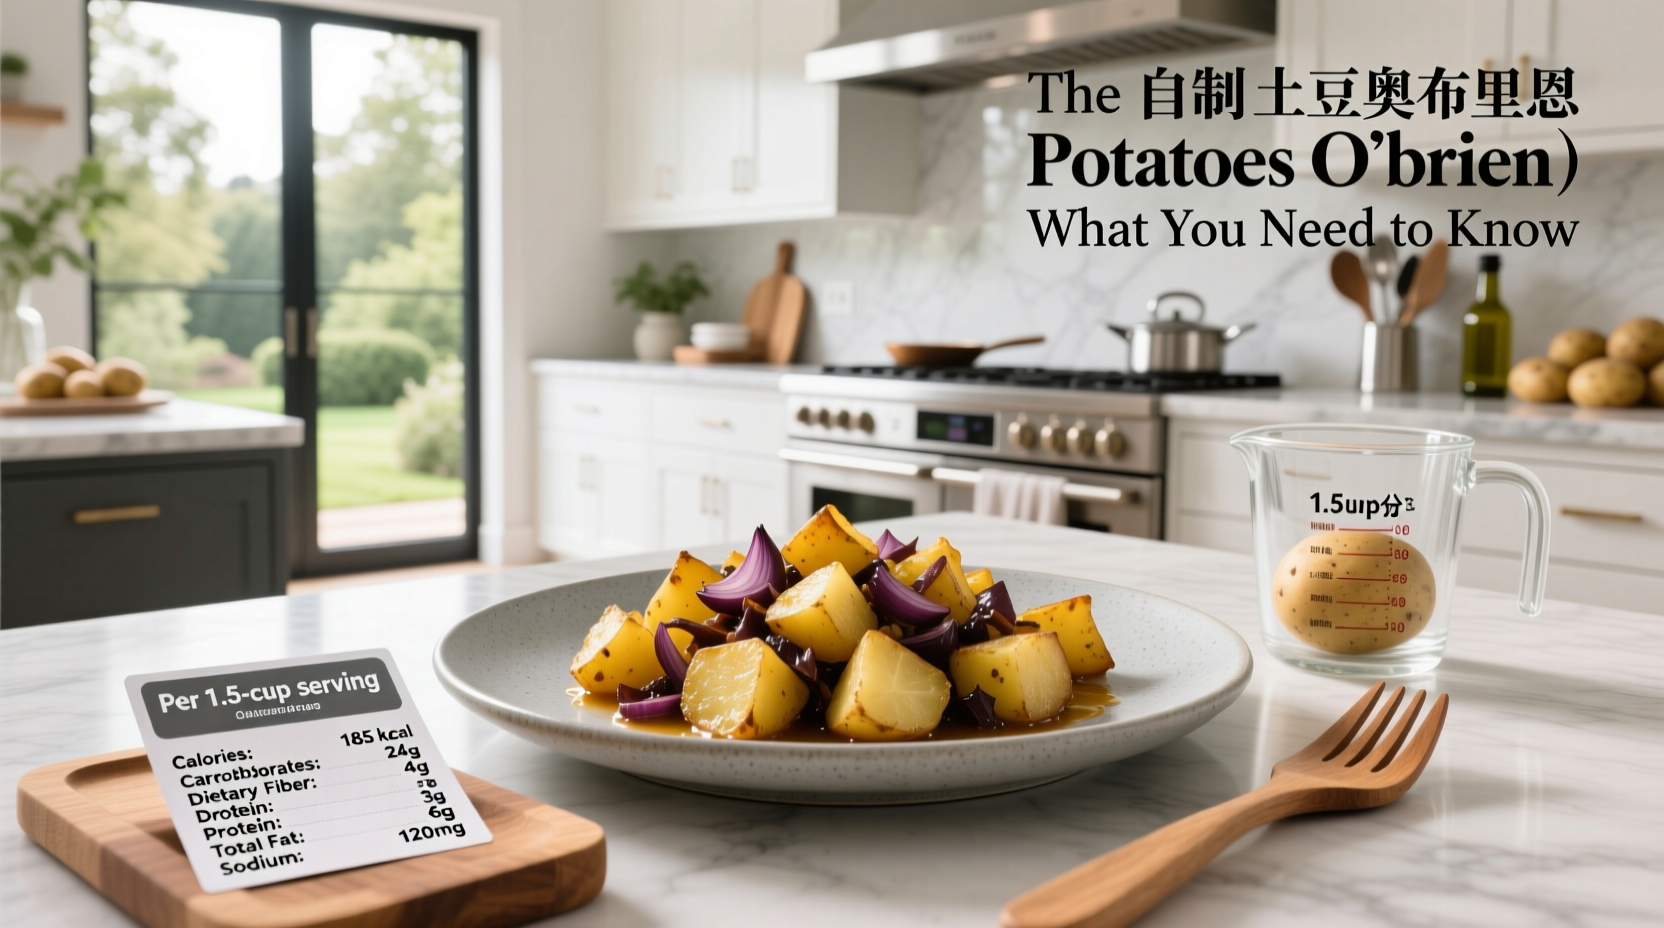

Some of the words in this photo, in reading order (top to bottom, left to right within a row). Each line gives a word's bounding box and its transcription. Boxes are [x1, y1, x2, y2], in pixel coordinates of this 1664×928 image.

[158, 693, 199, 714] Per
[204, 683, 291, 707] 1.5-cup
[298, 671, 380, 698] serving
[172, 748, 253, 770] Calories:
[340, 730, 374, 747] 185
[377, 724, 414, 742] kcal
[384, 744, 421, 760] 24g
[188, 785, 257, 807] Dietary
[264, 777, 317, 796] Fiber:
[403, 760, 430, 776] 4g
[196, 801, 274, 823] Drotein:
[203, 818, 282, 840] Protein:
[420, 790, 446, 805] 3g
[210, 840, 263, 858] Total
[268, 831, 305, 848] Fat:
[428, 805, 455, 822] 6g
[220, 851, 305, 876] Sodium:
[398, 822, 466, 843] 120mg
